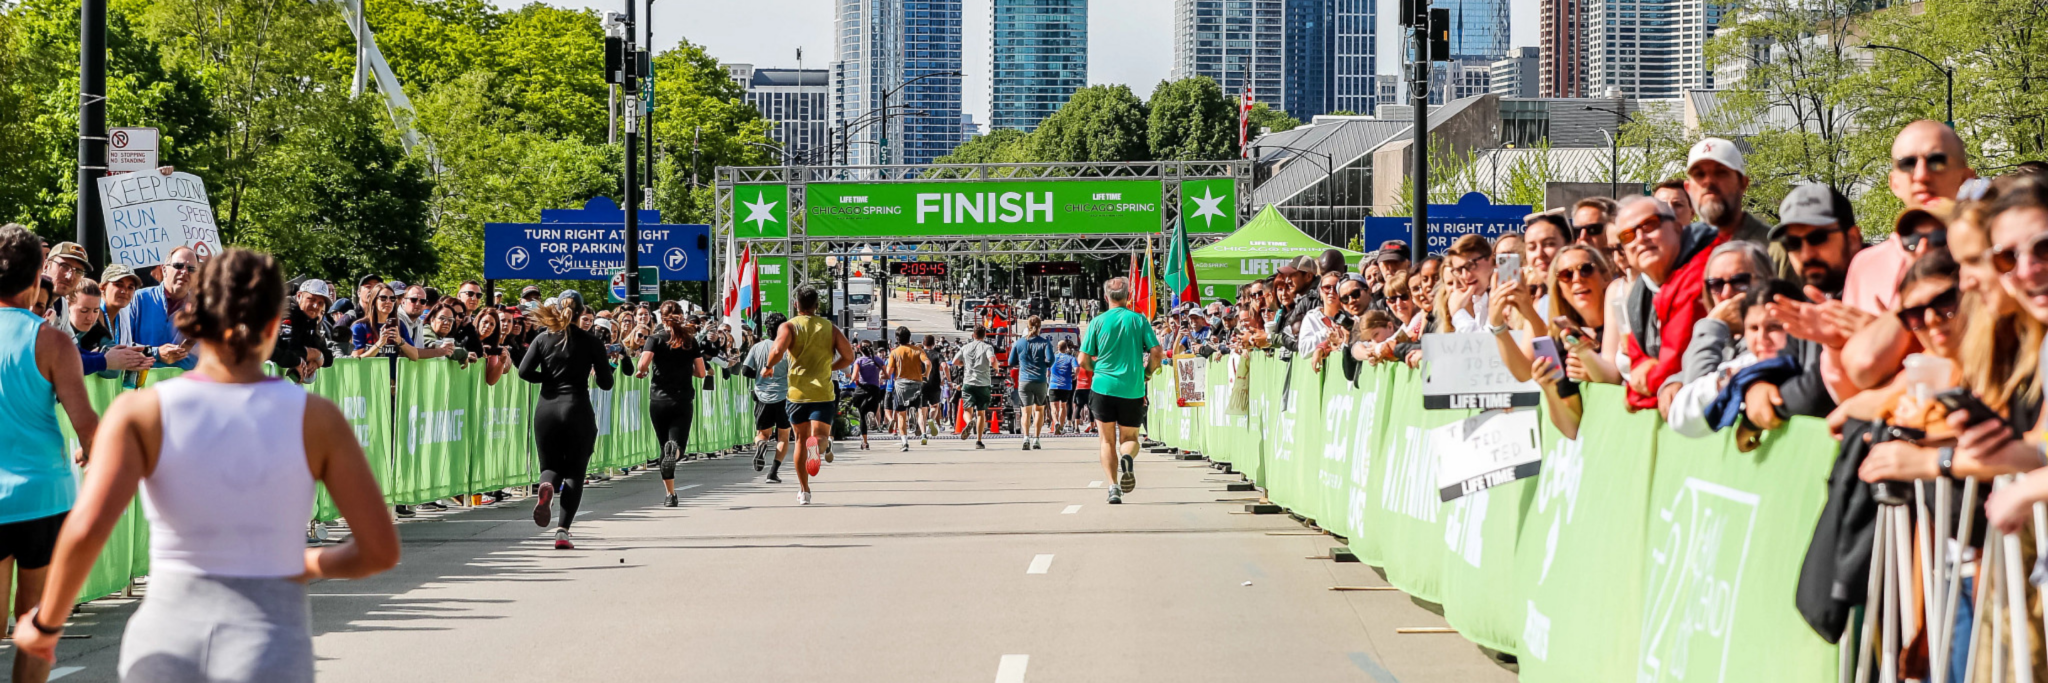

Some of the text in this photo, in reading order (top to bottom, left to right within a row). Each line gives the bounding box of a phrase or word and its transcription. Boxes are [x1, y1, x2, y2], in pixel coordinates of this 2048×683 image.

[104, 176, 207, 207] KEEP GOING
[177, 204, 213, 225] SPEED
[811, 206, 902, 215] CHICAGO SPRING
[916, 191, 1053, 224] FINISH
[1064, 203, 1155, 212] CHICAGO SPRING
[112, 206, 156, 231] RUN
[182, 224, 217, 243] BOOST
[524, 229, 670, 241] TURN RIGHT AT IGHT
[1444, 223, 1484, 234] RIGHT
[1487, 224, 1504, 234] AT
[1509, 224, 1528, 234] LIG
[110, 227, 170, 249] OLIVIA
[1428, 236, 1447, 246] OR
[120, 247, 161, 266] RUN
[540, 243, 568, 254] FOR
[638, 243, 654, 254] AT
[758, 264, 781, 275] TIME
[1240, 258, 1293, 275] LIFE TI
[1441, 339, 1484, 354] WAY
